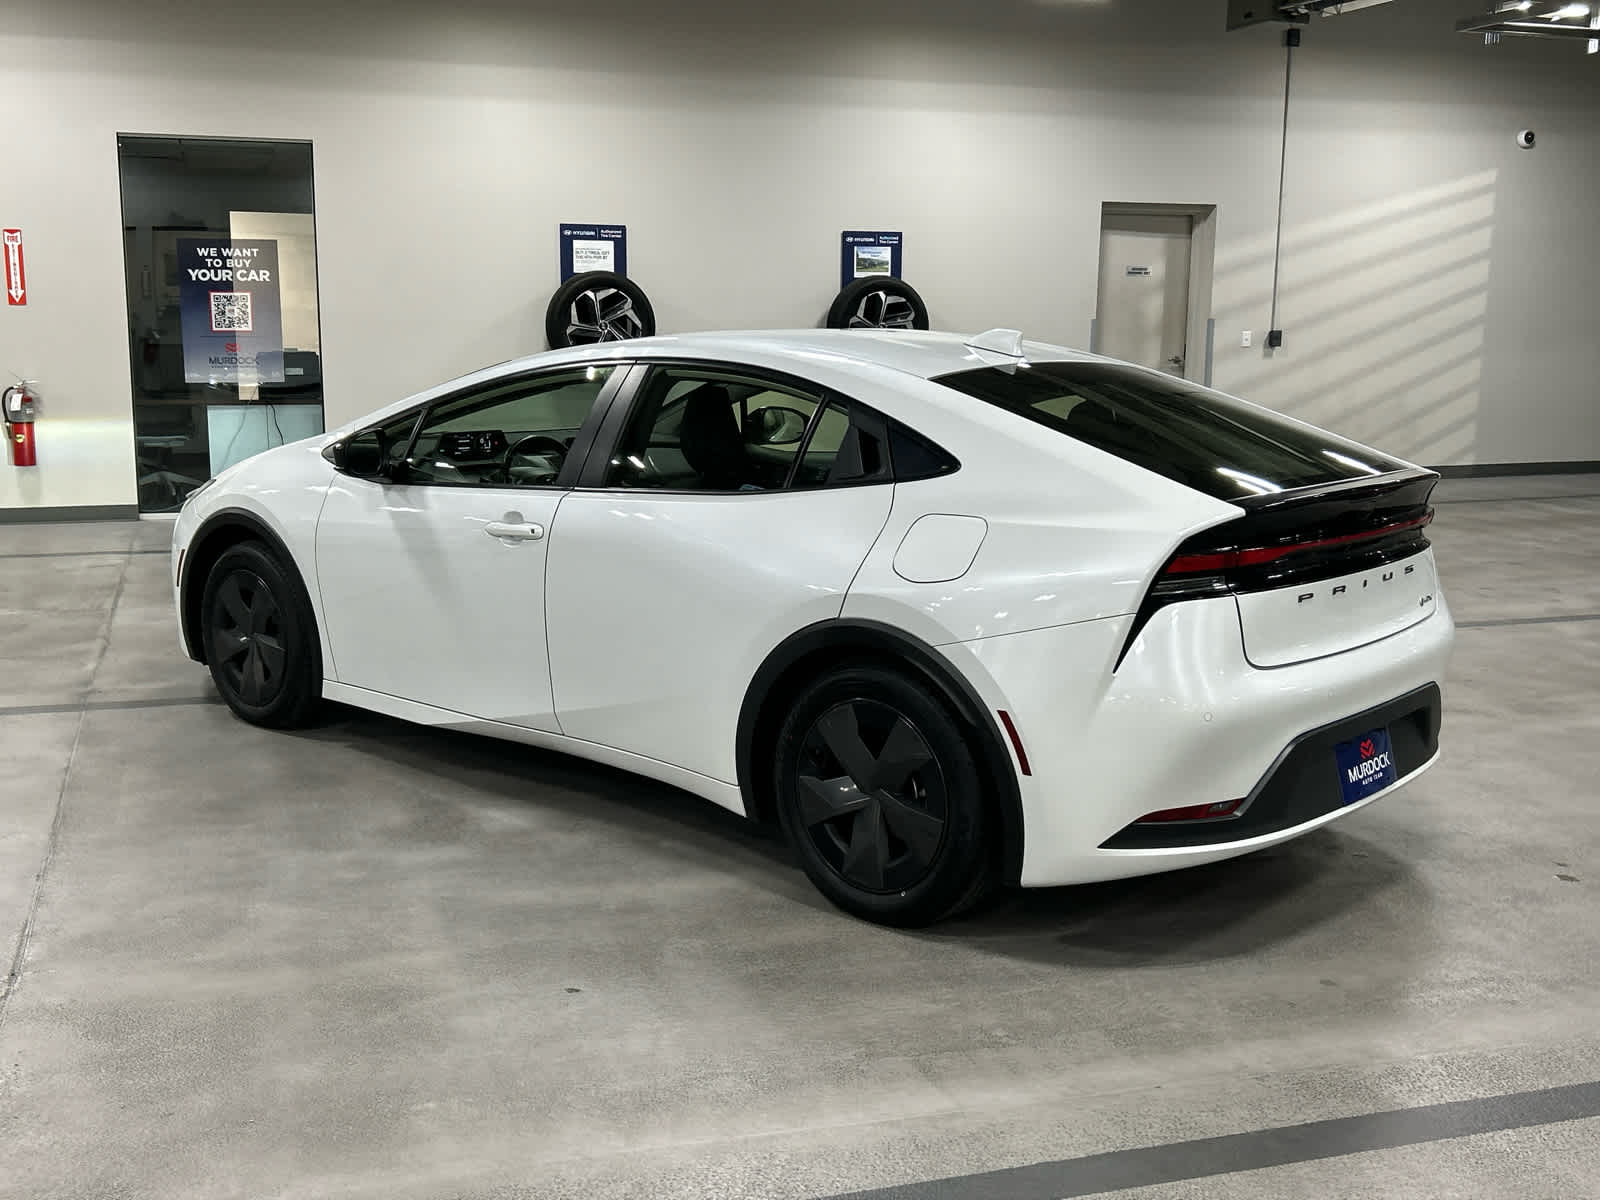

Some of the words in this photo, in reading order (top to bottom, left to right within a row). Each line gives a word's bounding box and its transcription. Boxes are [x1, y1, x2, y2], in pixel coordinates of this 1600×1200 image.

[196, 248, 218, 256] WE
[220, 248, 259, 256] WANT
[205, 258, 222, 268] TO
[226, 259, 252, 268] BUY
[187, 269, 232, 281] YOUR
[236, 270, 270, 282] CAR
[208, 356, 261, 365] MURDOCK
[1298, 564, 1414, 603] PRIUS
[1348, 751, 1390, 784] MURDOCK
